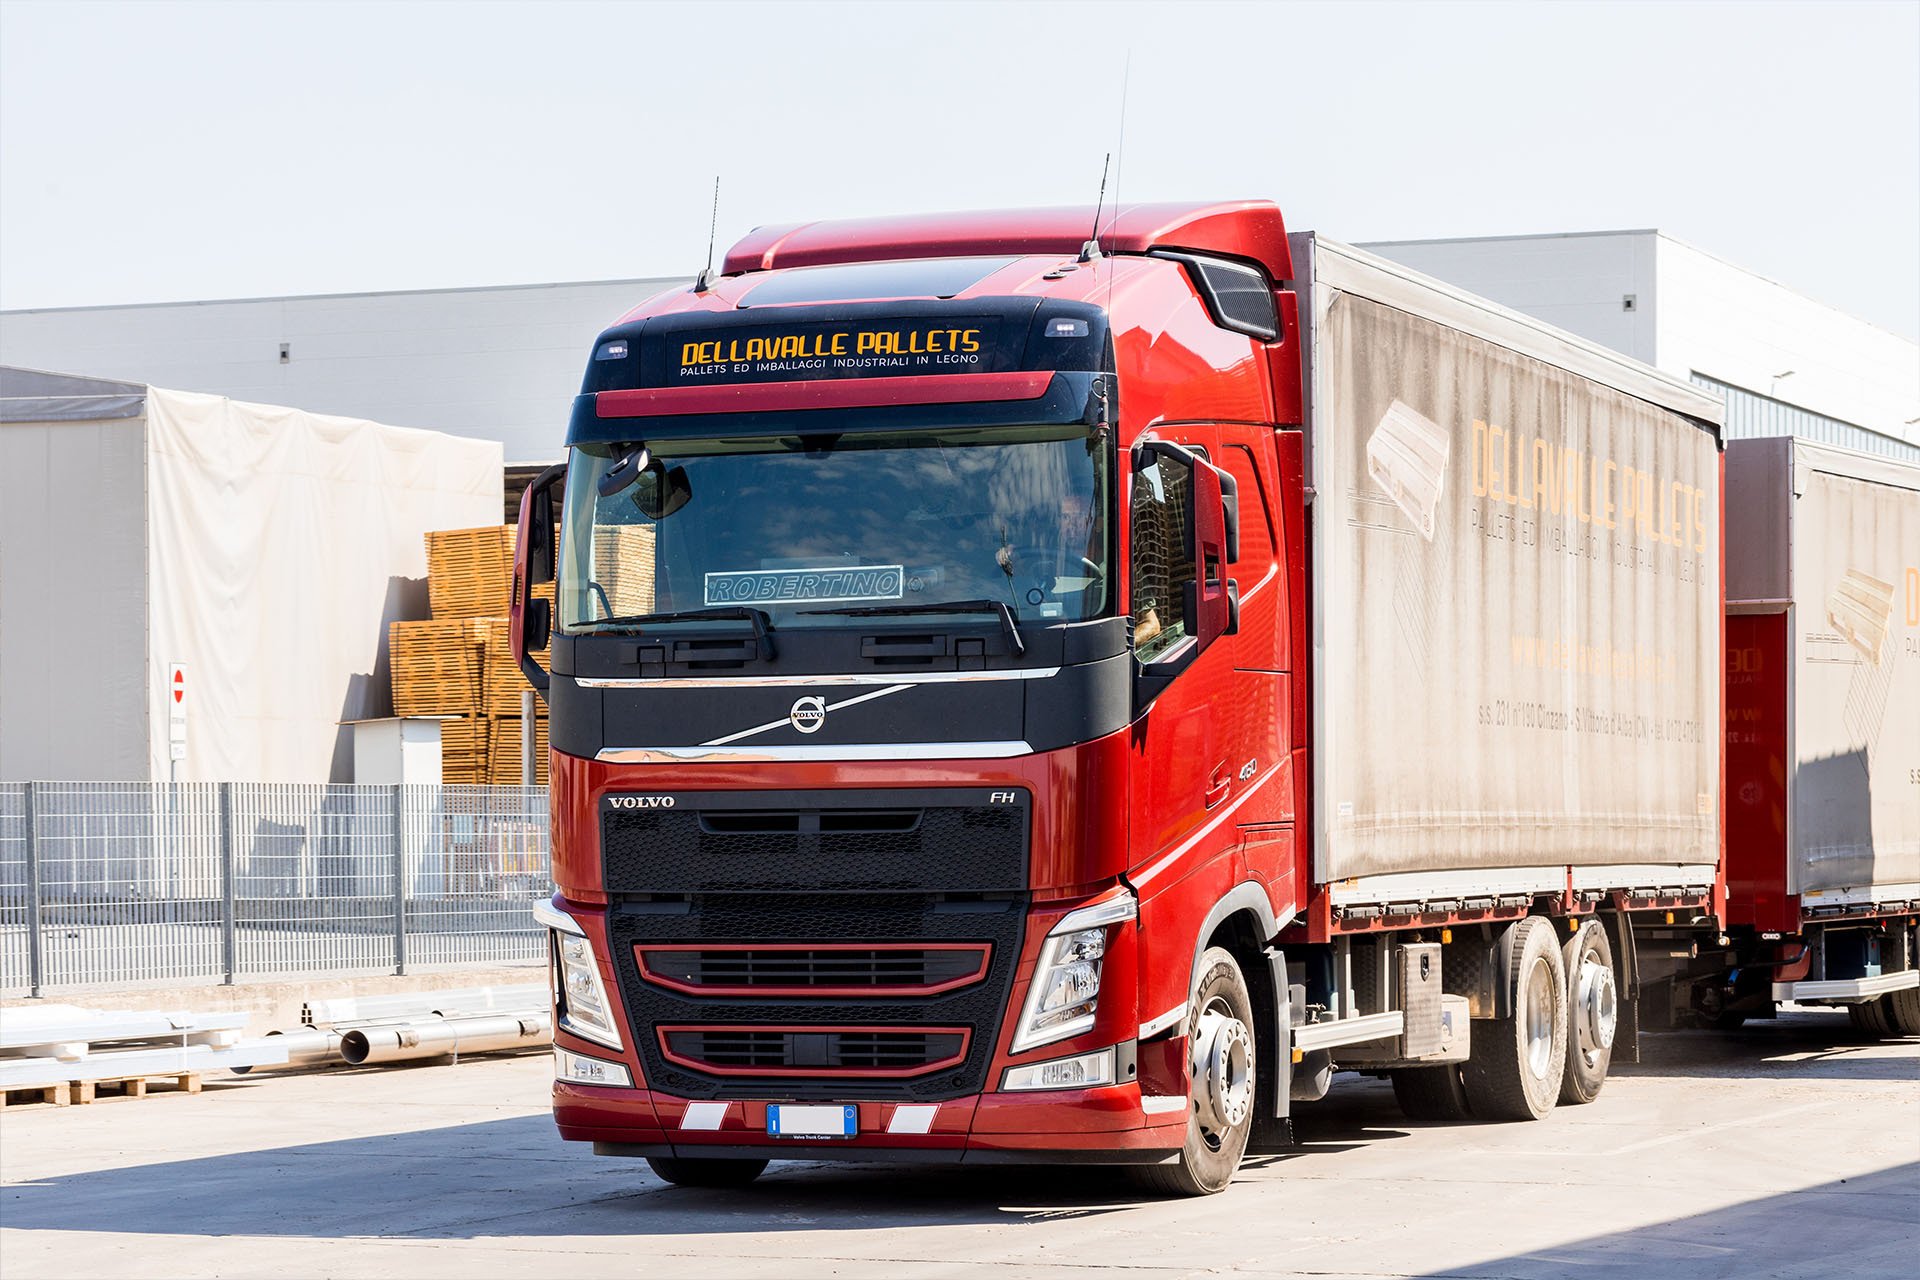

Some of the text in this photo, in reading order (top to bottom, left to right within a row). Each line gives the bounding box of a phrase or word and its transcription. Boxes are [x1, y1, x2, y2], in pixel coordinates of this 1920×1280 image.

[681, 329, 981, 367] DELLAVALLE PALLETS
[680, 354, 979, 377] PALLETS ED IMBALLAGGI INDUSTRIALI IN LEGNO
[1472, 418, 1706, 554] DELLAVALLE PALLETS
[711, 571, 900, 600] ROBERTINO
[608, 796, 675, 809] VOLVO
[990, 792, 1015, 803] FH
